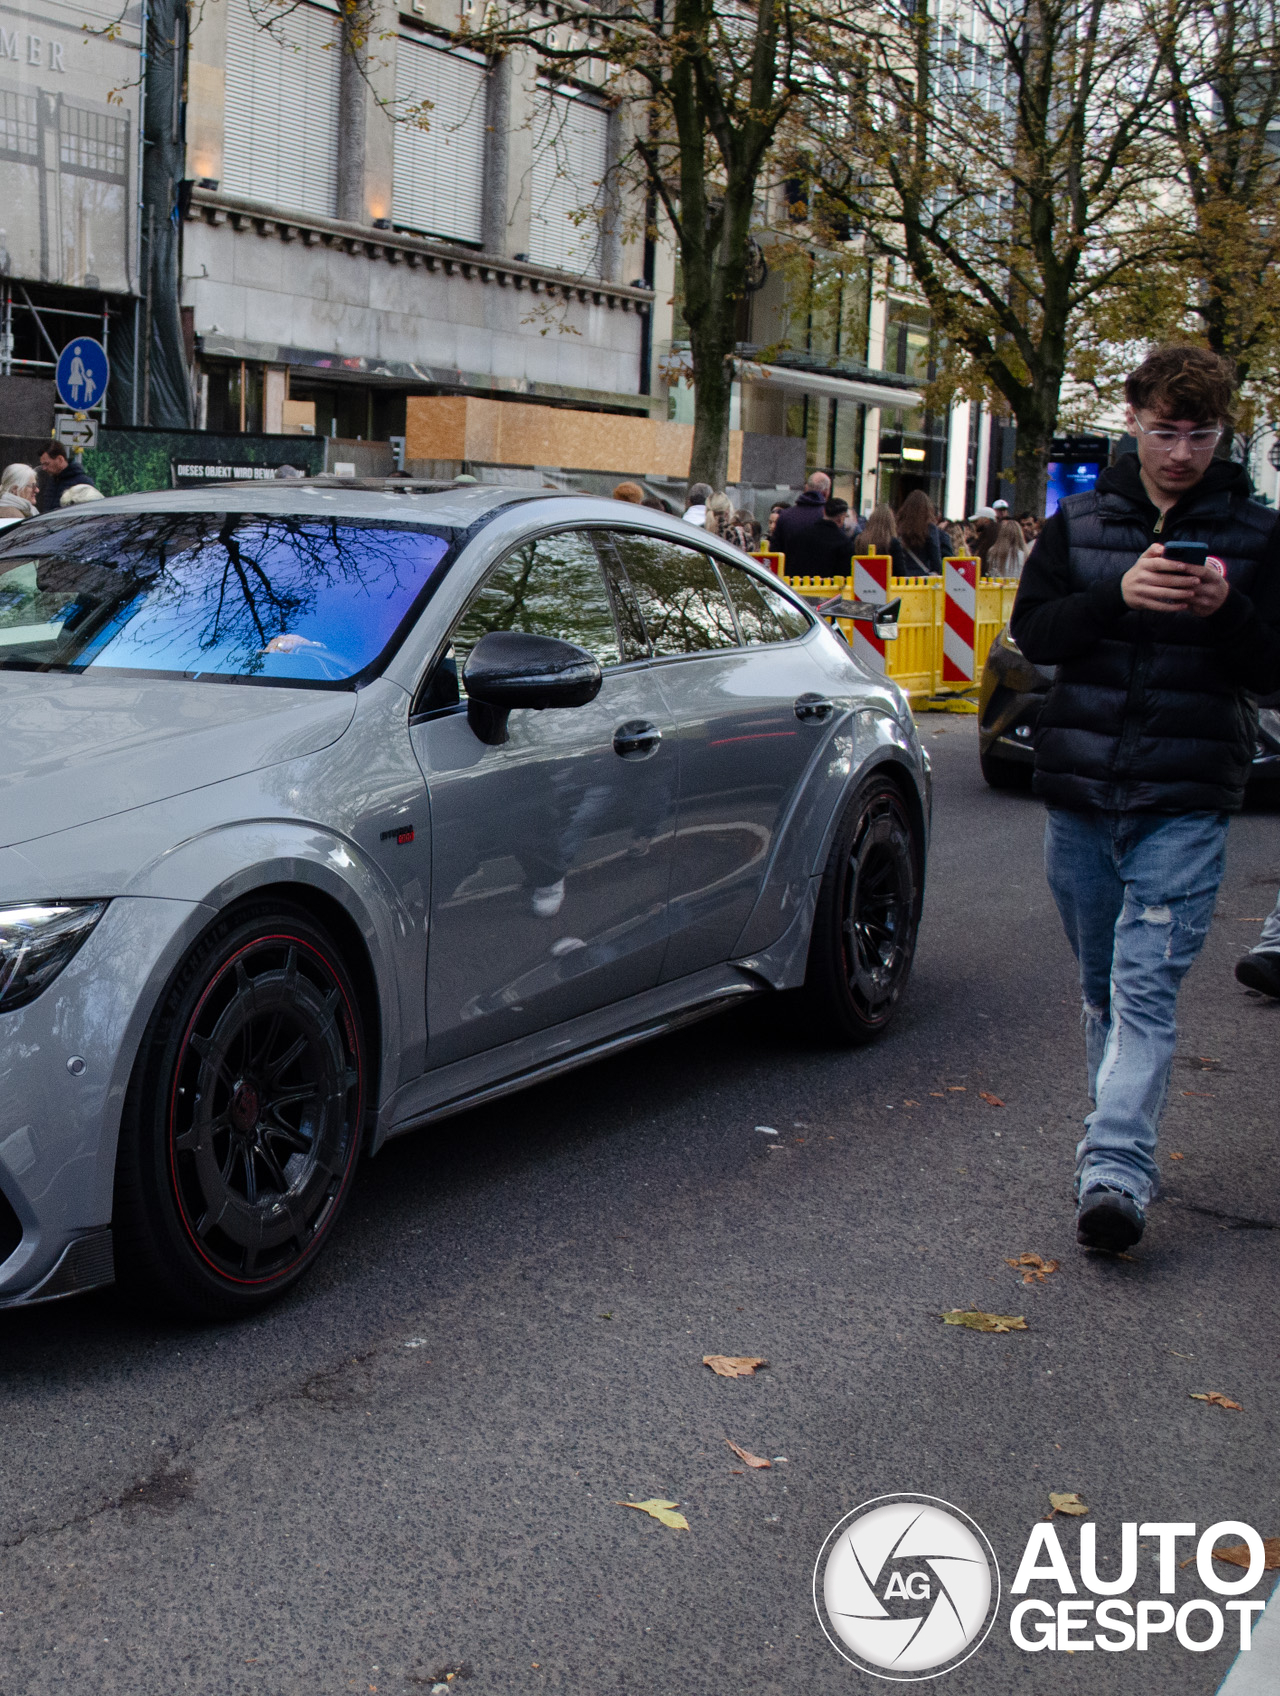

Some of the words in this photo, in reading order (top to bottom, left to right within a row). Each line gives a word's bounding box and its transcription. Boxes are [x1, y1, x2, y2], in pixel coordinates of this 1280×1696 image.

[177, 464, 204, 476] DIESES
[205, 466, 232, 478] OBJEKT
[233, 467, 253, 479] WIRD
[254, 468, 278, 480] BEWA
